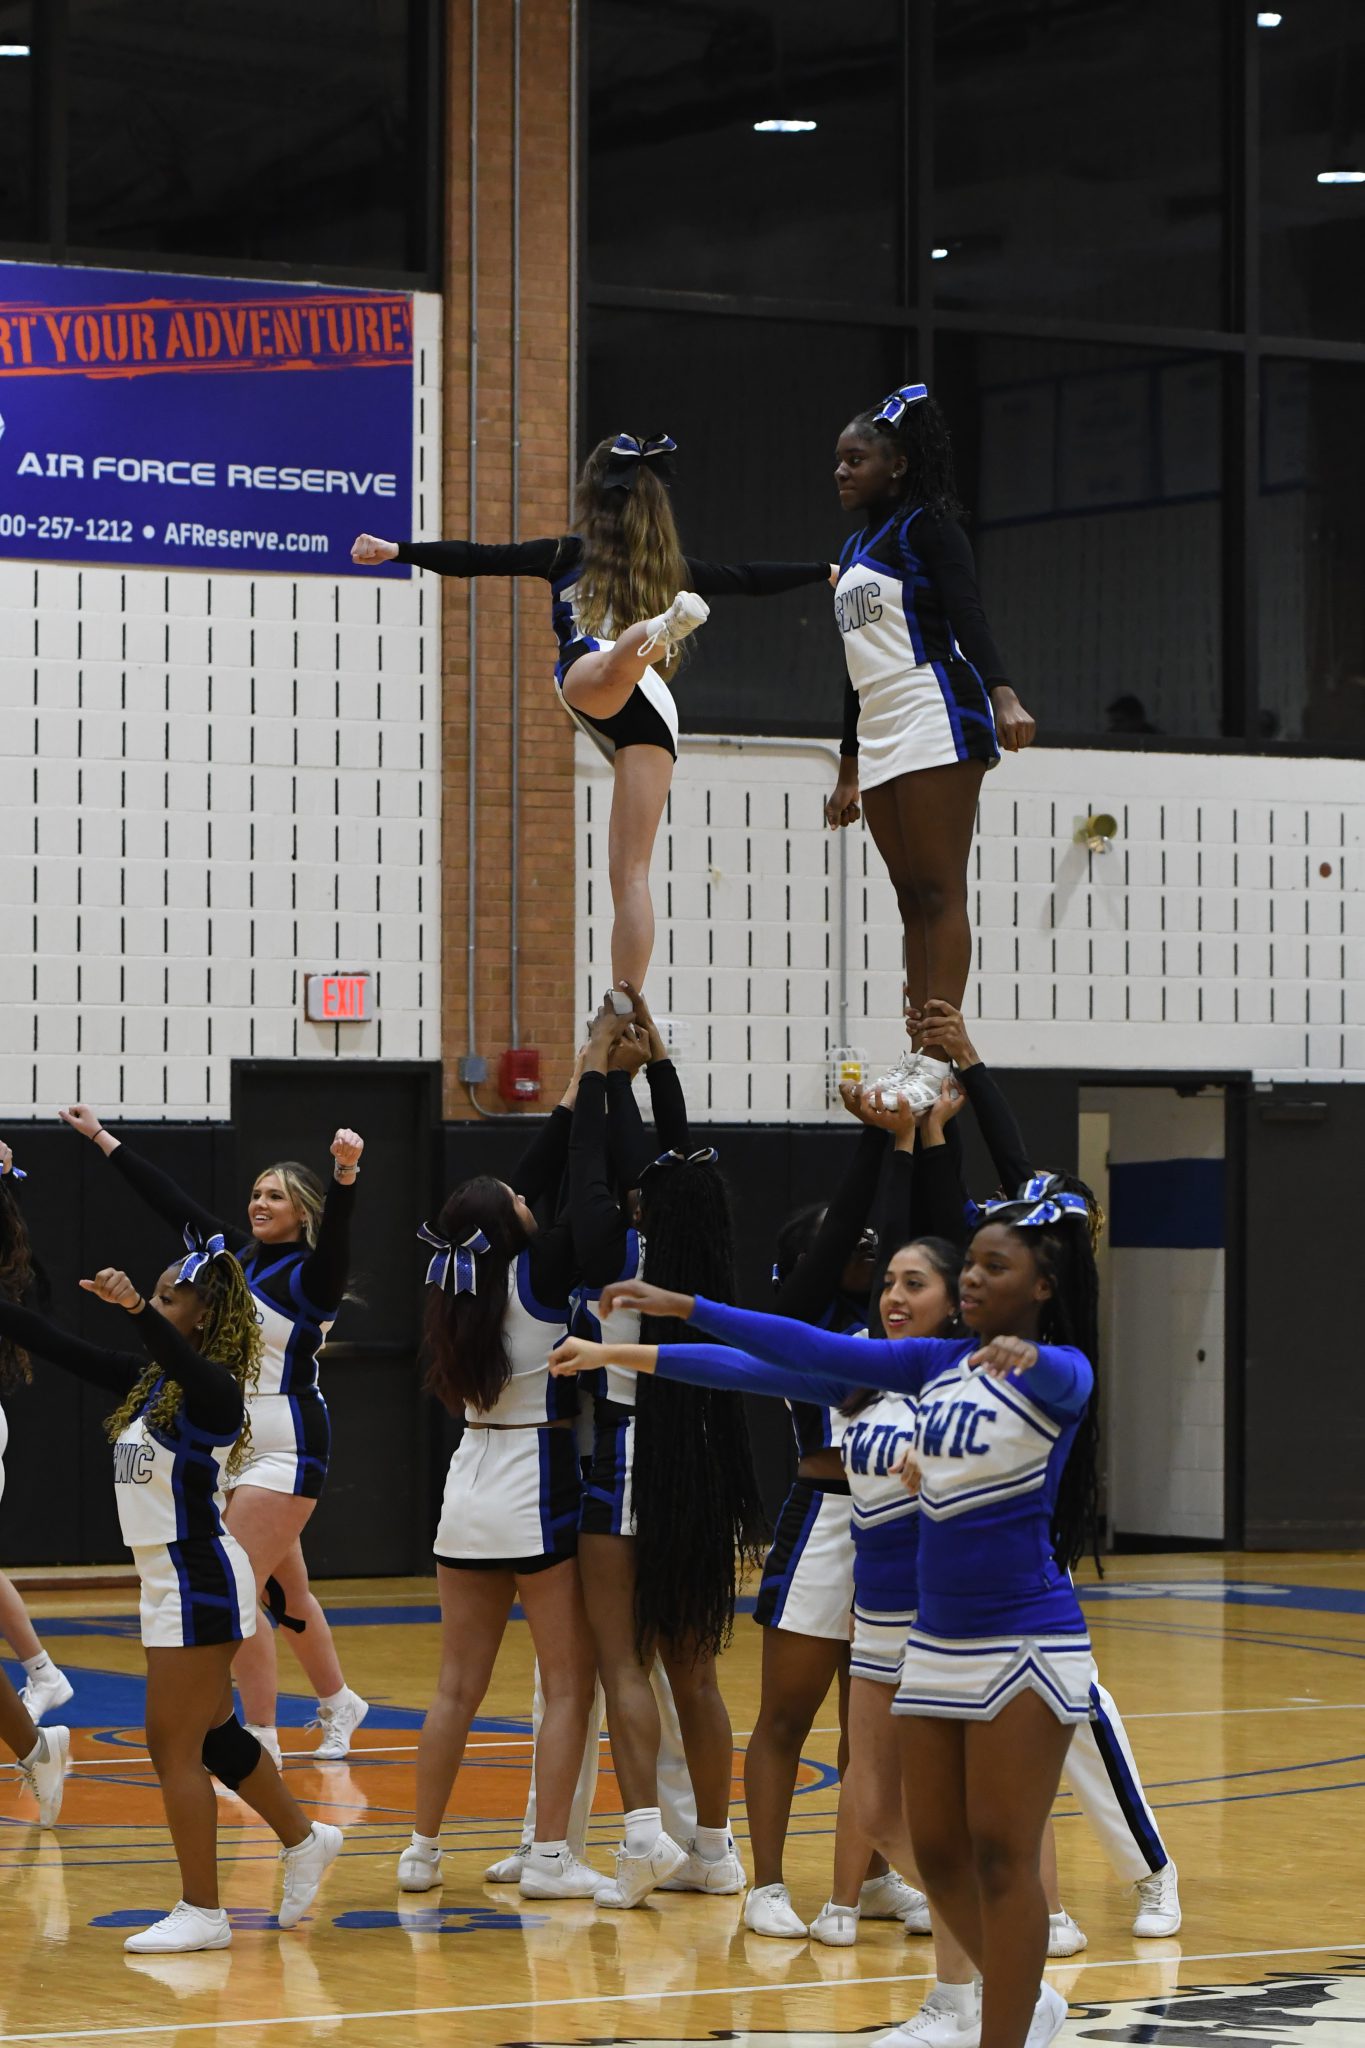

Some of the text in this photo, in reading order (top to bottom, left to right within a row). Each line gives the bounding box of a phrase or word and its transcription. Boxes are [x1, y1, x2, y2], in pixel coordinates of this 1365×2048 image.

[44, 313, 157, 362] YOUR
[166, 306, 405, 359] ADVENTURE
[17, 452, 397, 497] AIR FORCE RESERVE
[0, 513, 329, 553] 00-257-1212 AFReserve.com
[323, 978, 367, 1017] EXIT
[113, 1443, 155, 1484] WIC
